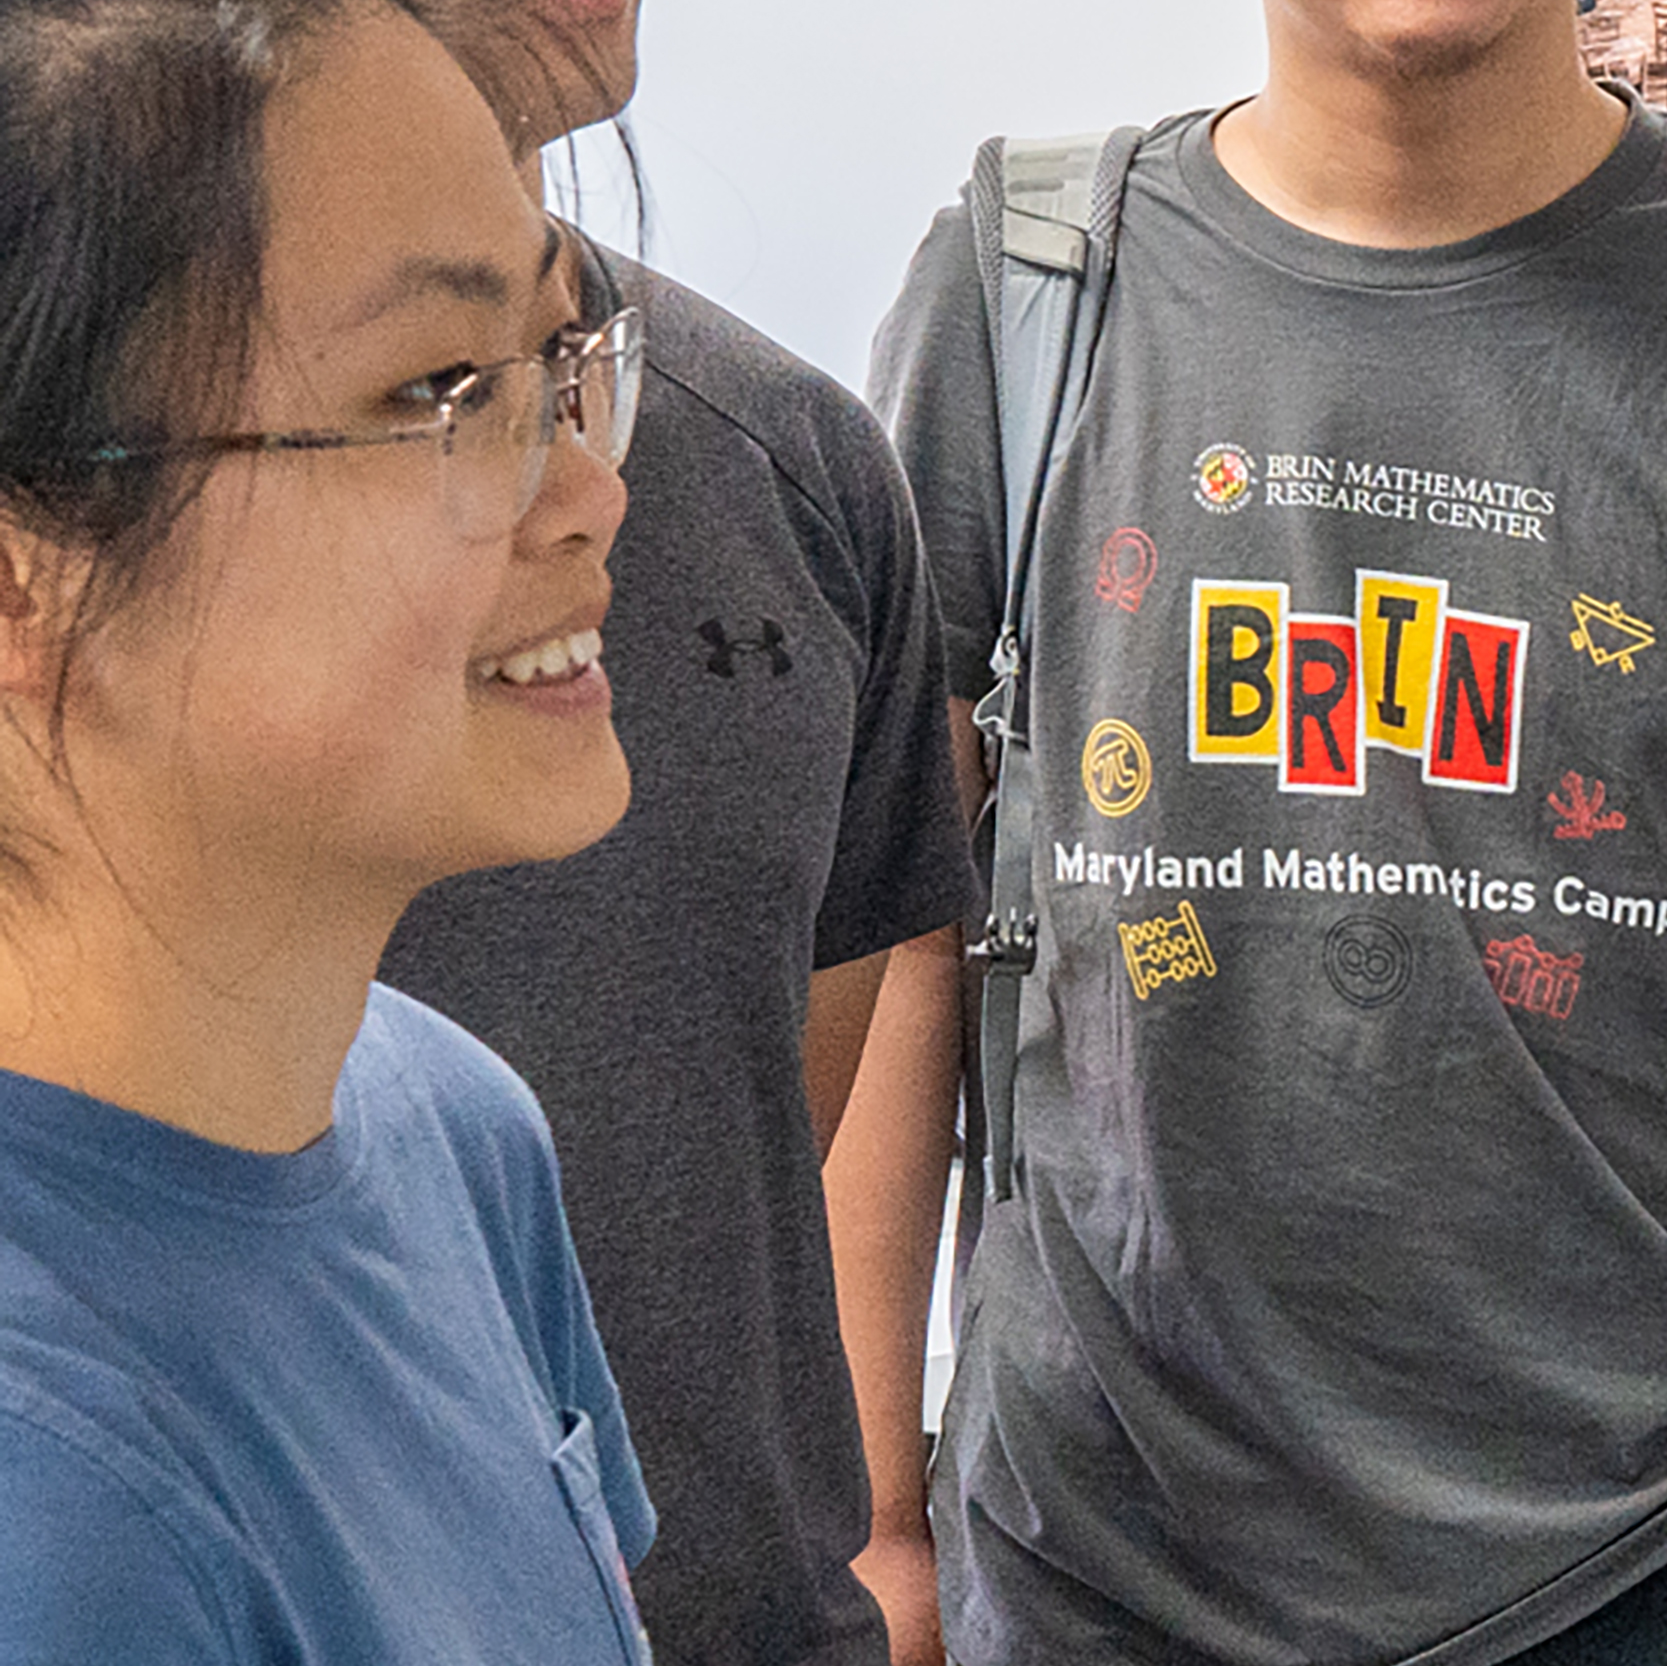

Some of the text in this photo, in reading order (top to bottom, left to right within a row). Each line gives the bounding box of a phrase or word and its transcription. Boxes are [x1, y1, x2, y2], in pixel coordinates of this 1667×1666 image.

[1265, 482, 1417, 521] RESEARCH
[1427, 499, 1547, 543] CENTER
[1266, 454, 1336, 482] BRIN
[1344, 461, 1556, 515] MATHEMATICS
[1205, 595, 1510, 774] BRIN
[1053, 842, 1244, 896] Maryland
[1262, 848, 1537, 914] Mathemtics
